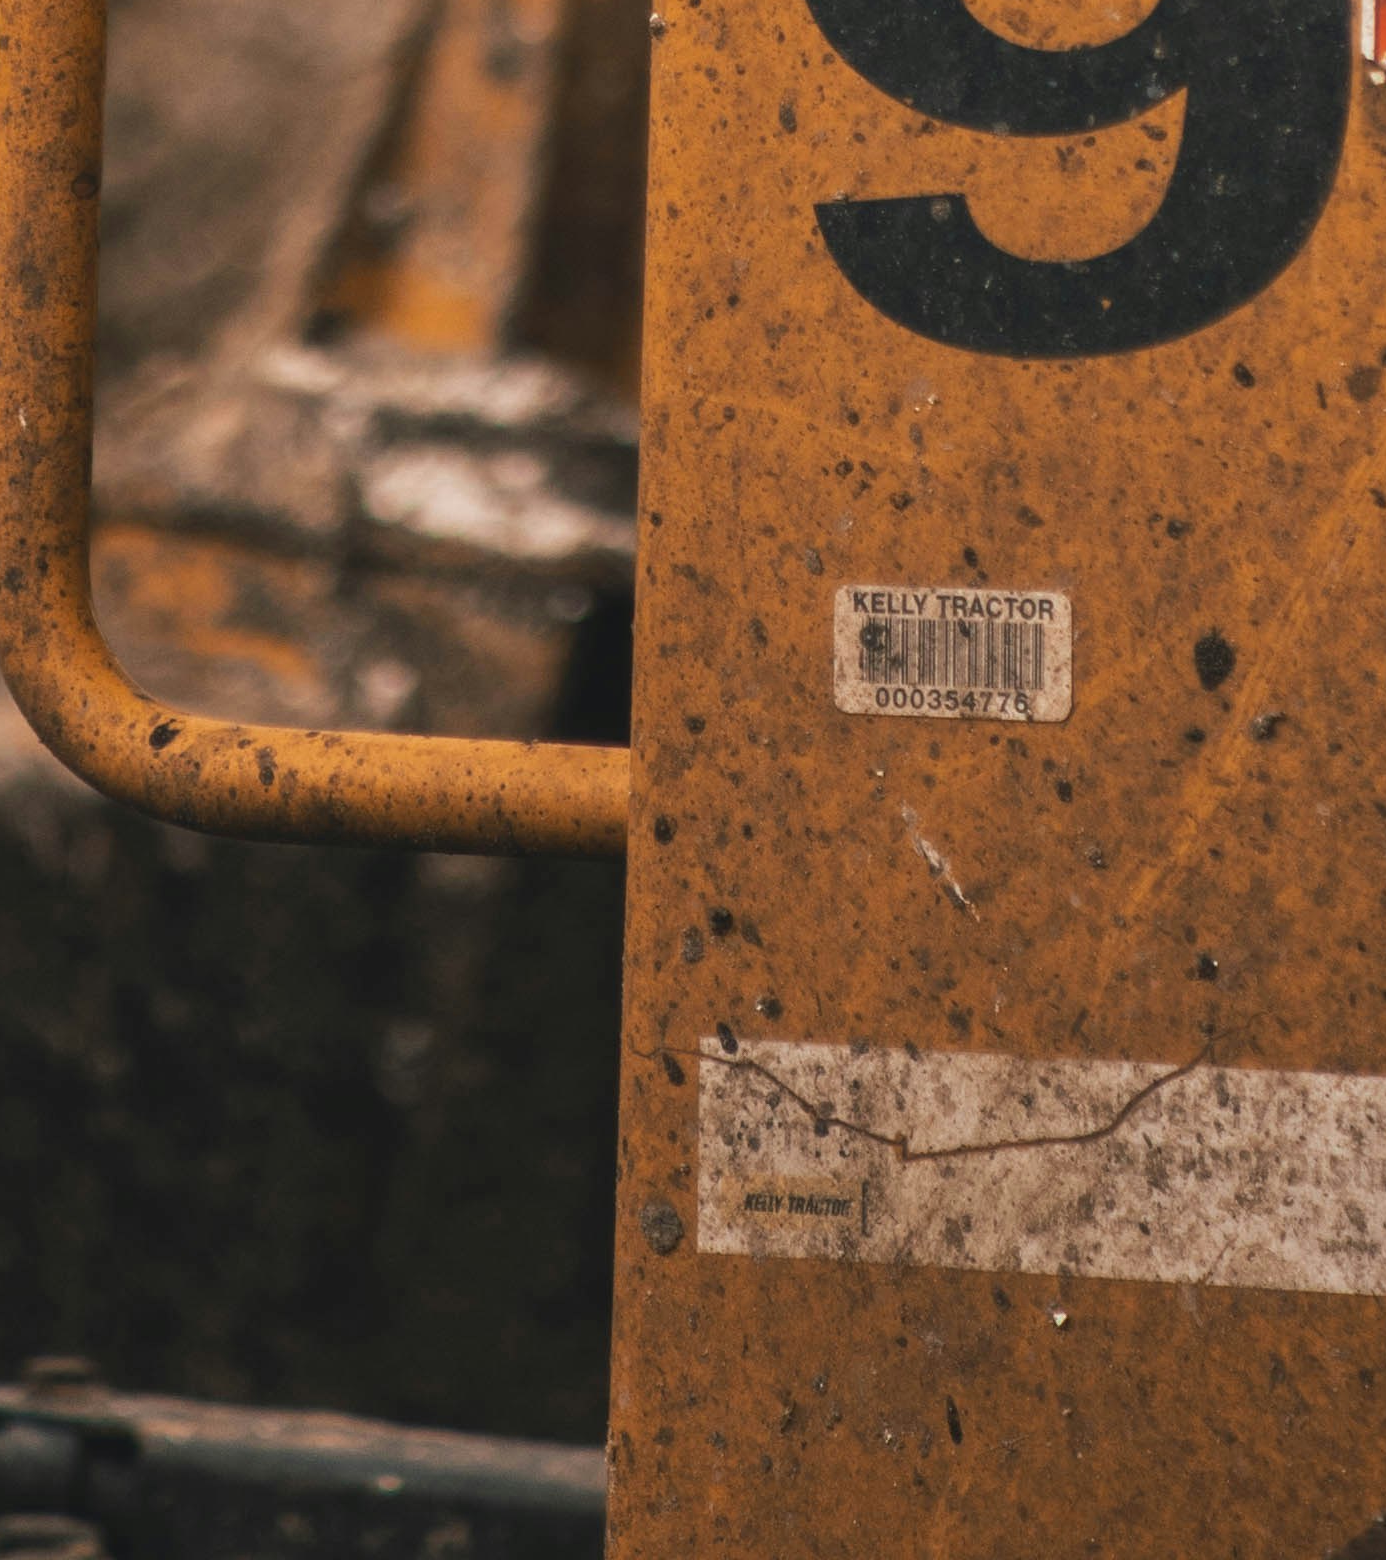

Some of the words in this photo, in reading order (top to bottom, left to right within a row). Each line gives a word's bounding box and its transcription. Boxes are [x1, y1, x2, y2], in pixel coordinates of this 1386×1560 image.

[853, 591, 929, 615] KELLY
[936, 594, 1055, 620] TRACTOR
[875, 686, 1030, 714] 000354776
[744, 1192, 784, 1214] KELLY
[788, 1194, 852, 1217] TRACTOR
